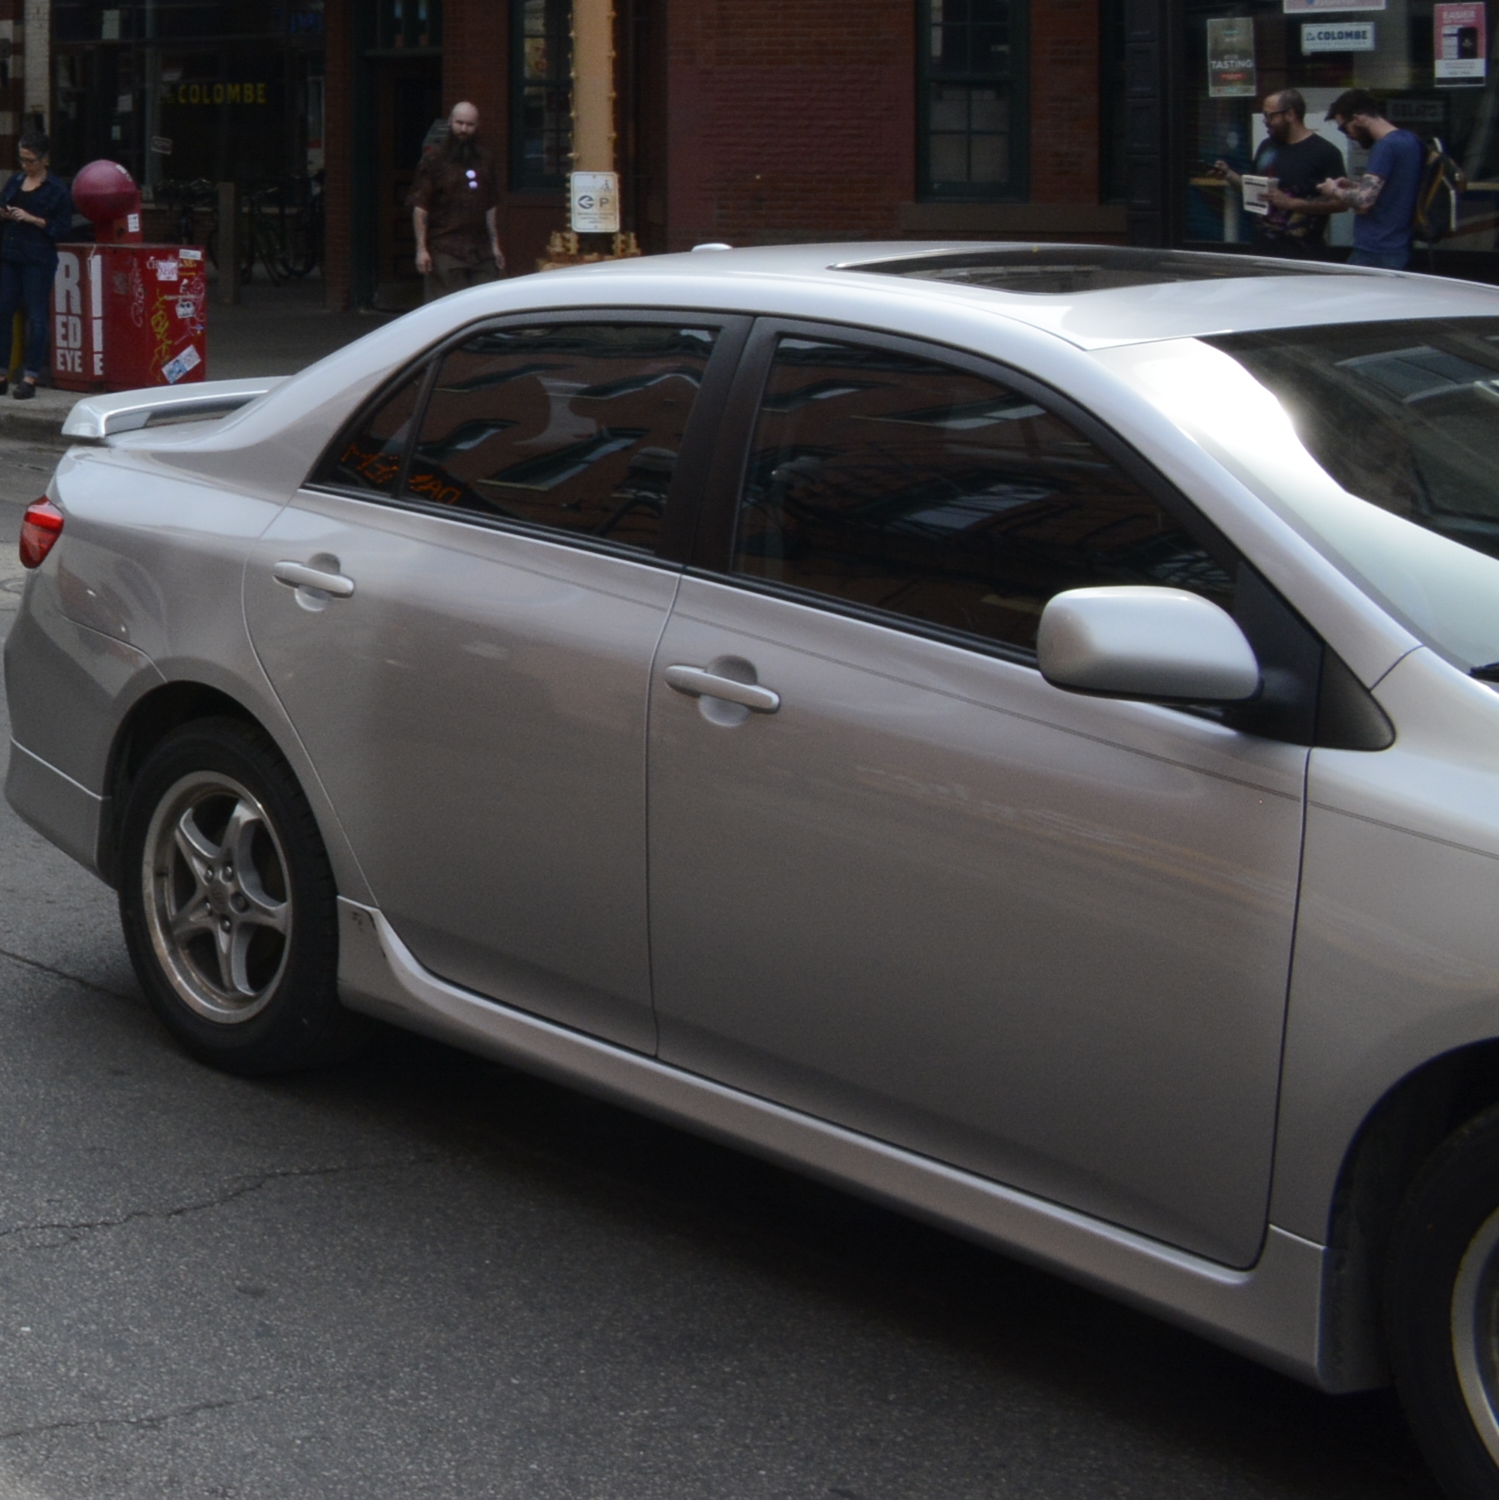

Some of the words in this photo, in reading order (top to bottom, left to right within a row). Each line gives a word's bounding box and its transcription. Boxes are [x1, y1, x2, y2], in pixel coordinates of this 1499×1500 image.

[1317, 30, 1368, 41] COLOMBE
[1210, 59, 1253, 69] TASTING
[178, 82, 267, 105] COLOMBE
[599, 197, 609, 207] P
[56, 349, 83, 373] EYE
